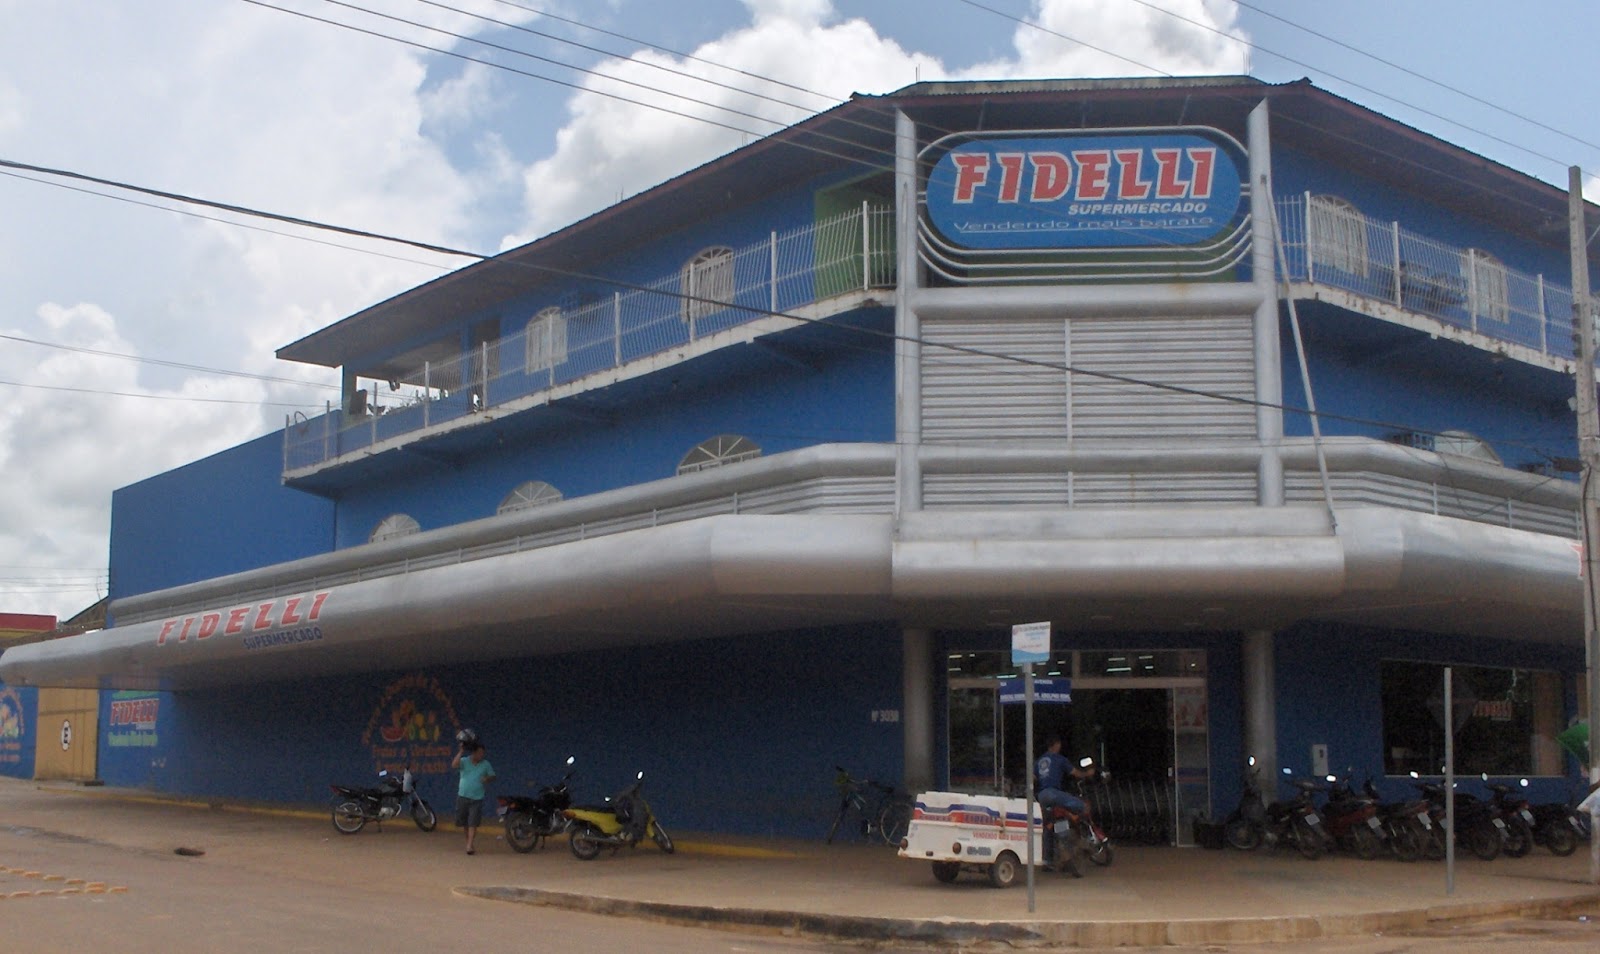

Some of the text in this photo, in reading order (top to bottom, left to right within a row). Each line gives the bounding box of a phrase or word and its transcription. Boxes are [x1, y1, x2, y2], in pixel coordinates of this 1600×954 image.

[951, 148, 1216, 203] FIDELLI
[1068, 202, 1207, 216] SUPERMERCADO
[953, 216, 1213, 232] Vendendo mais barato
[157, 592, 330, 646] FIDELLI
[243, 627, 323, 650] SUPERMERCADO
[110, 698, 160, 725] FIDELLI
